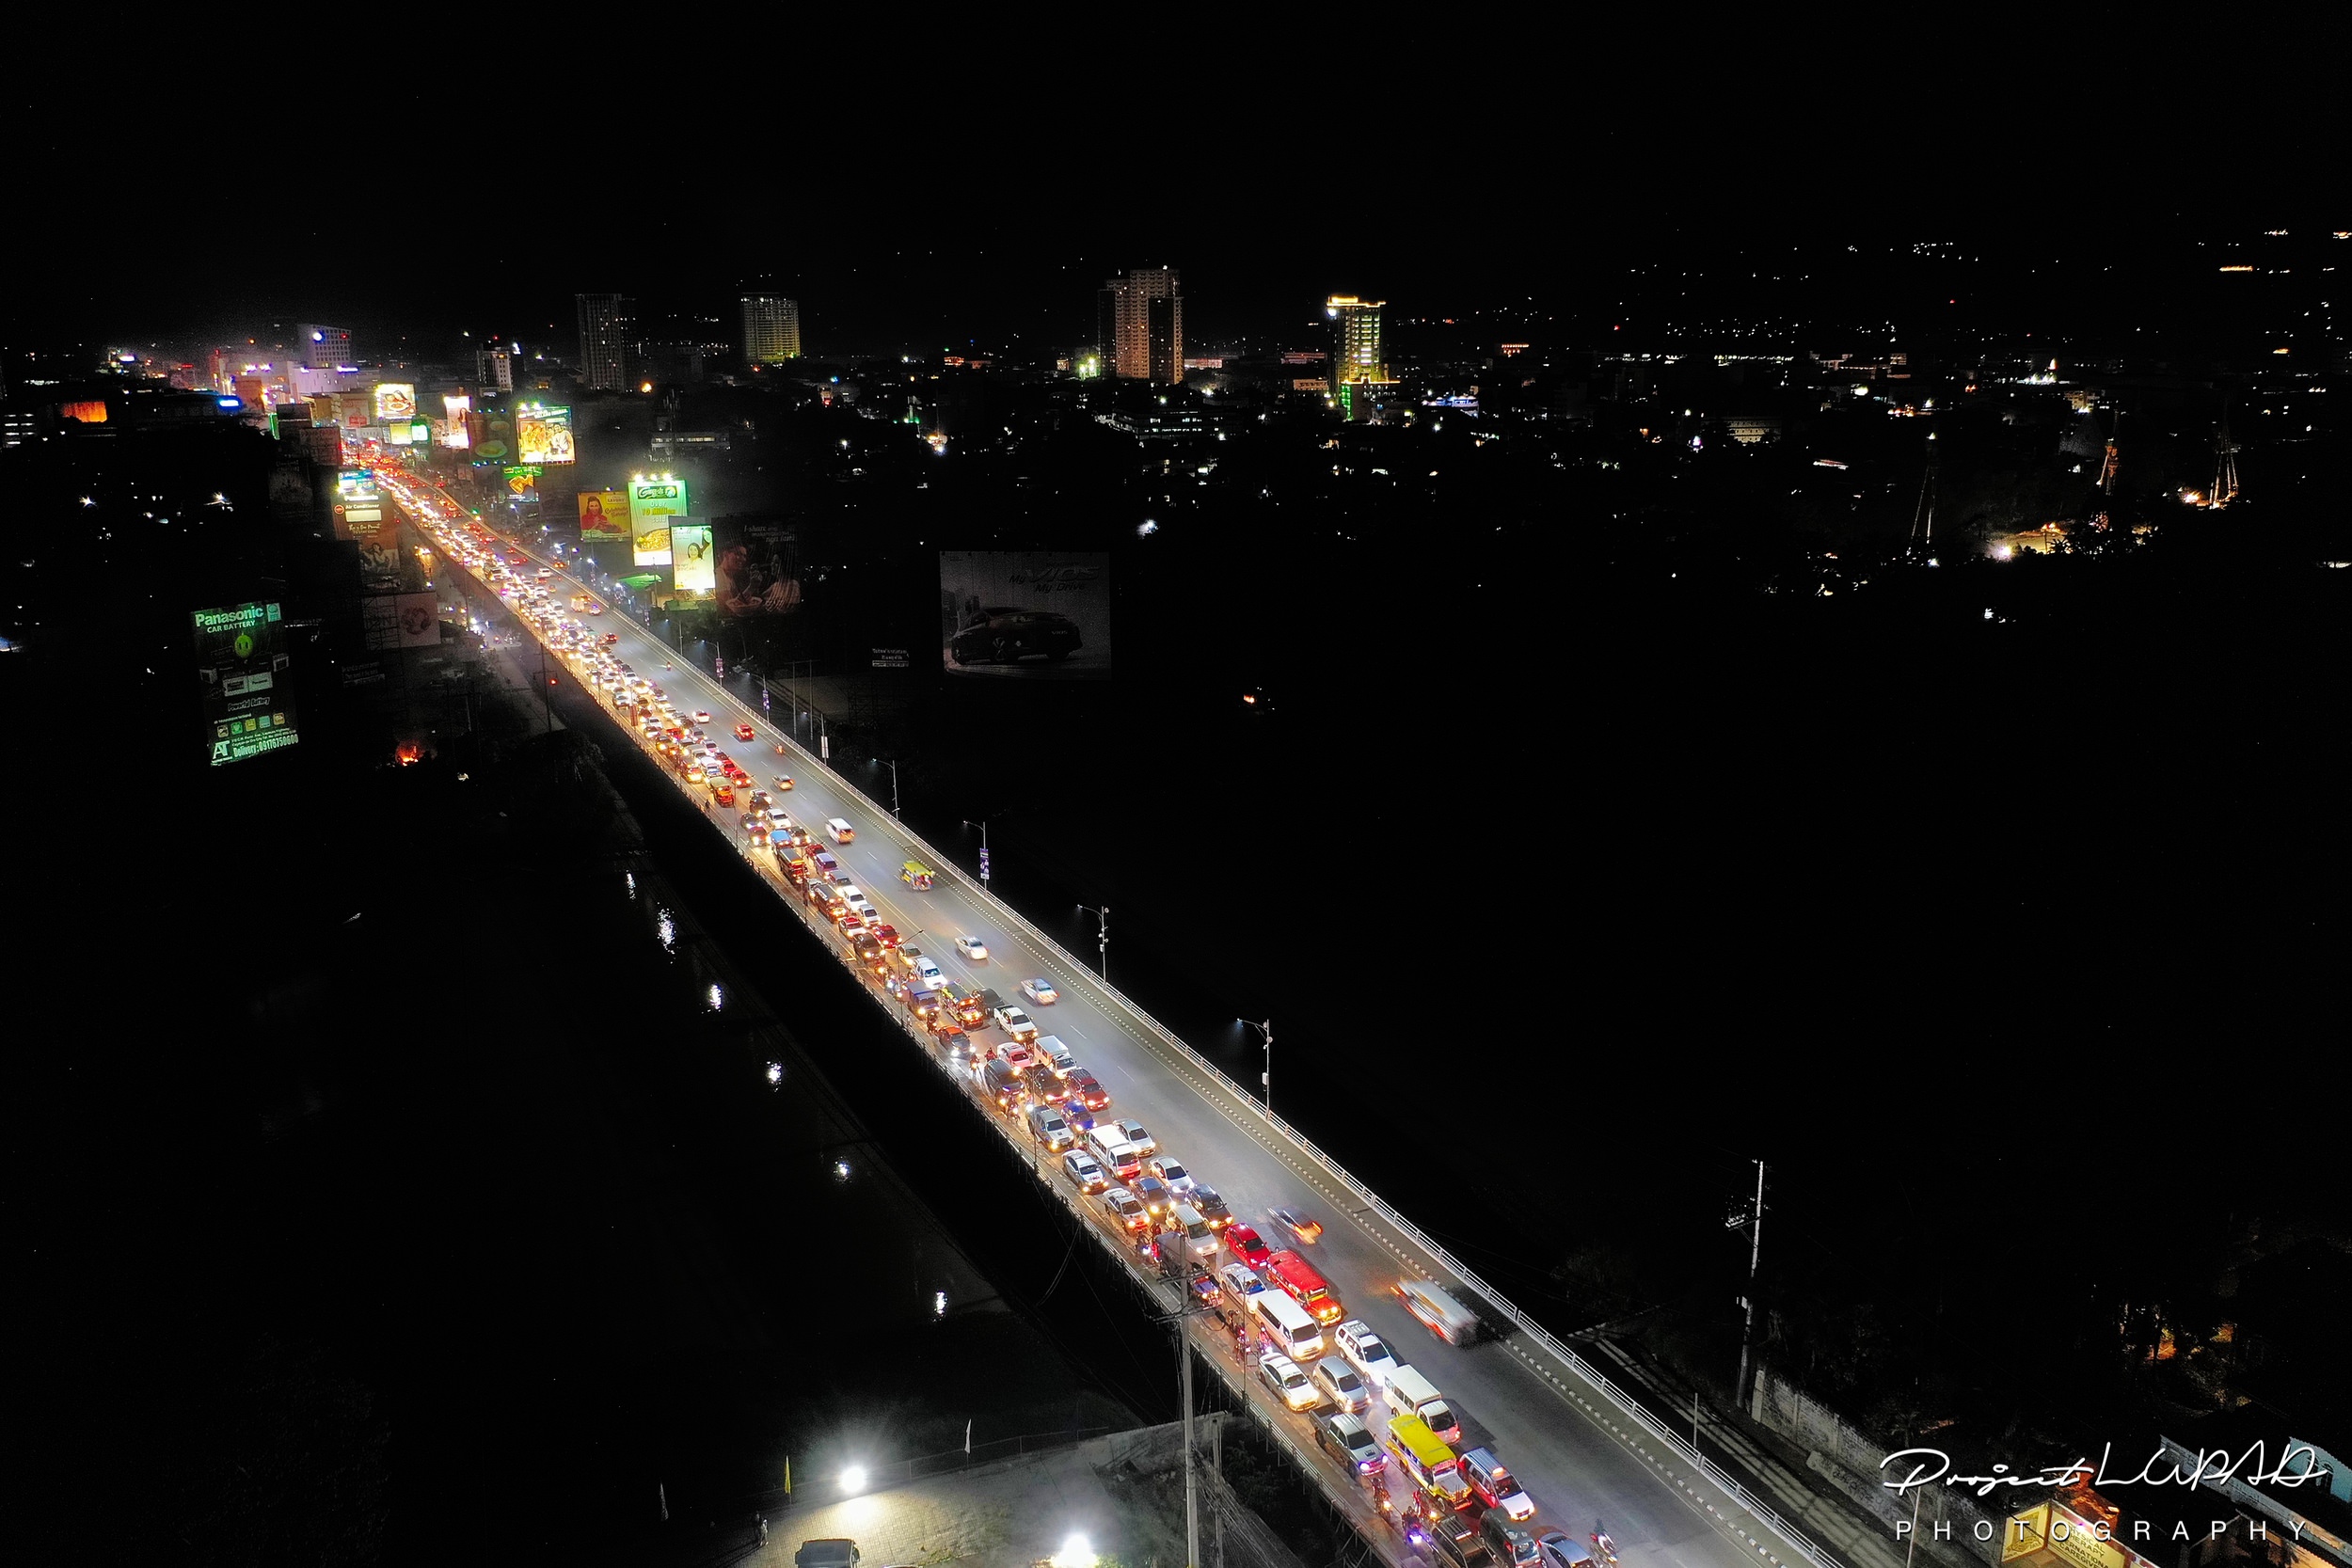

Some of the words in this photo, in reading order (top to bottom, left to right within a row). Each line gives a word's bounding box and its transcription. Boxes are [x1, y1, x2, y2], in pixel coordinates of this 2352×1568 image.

[1009, 575, 1026, 585] My
[1035, 583, 1053, 594] My
[1057, 583, 1086, 592] Drive
[195, 606, 264, 627] Panasonic
[207, 625, 223, 634] CAR
[223, 620, 256, 631] BATTERY
[2065, 1529, 2105, 1558] HERAPY
